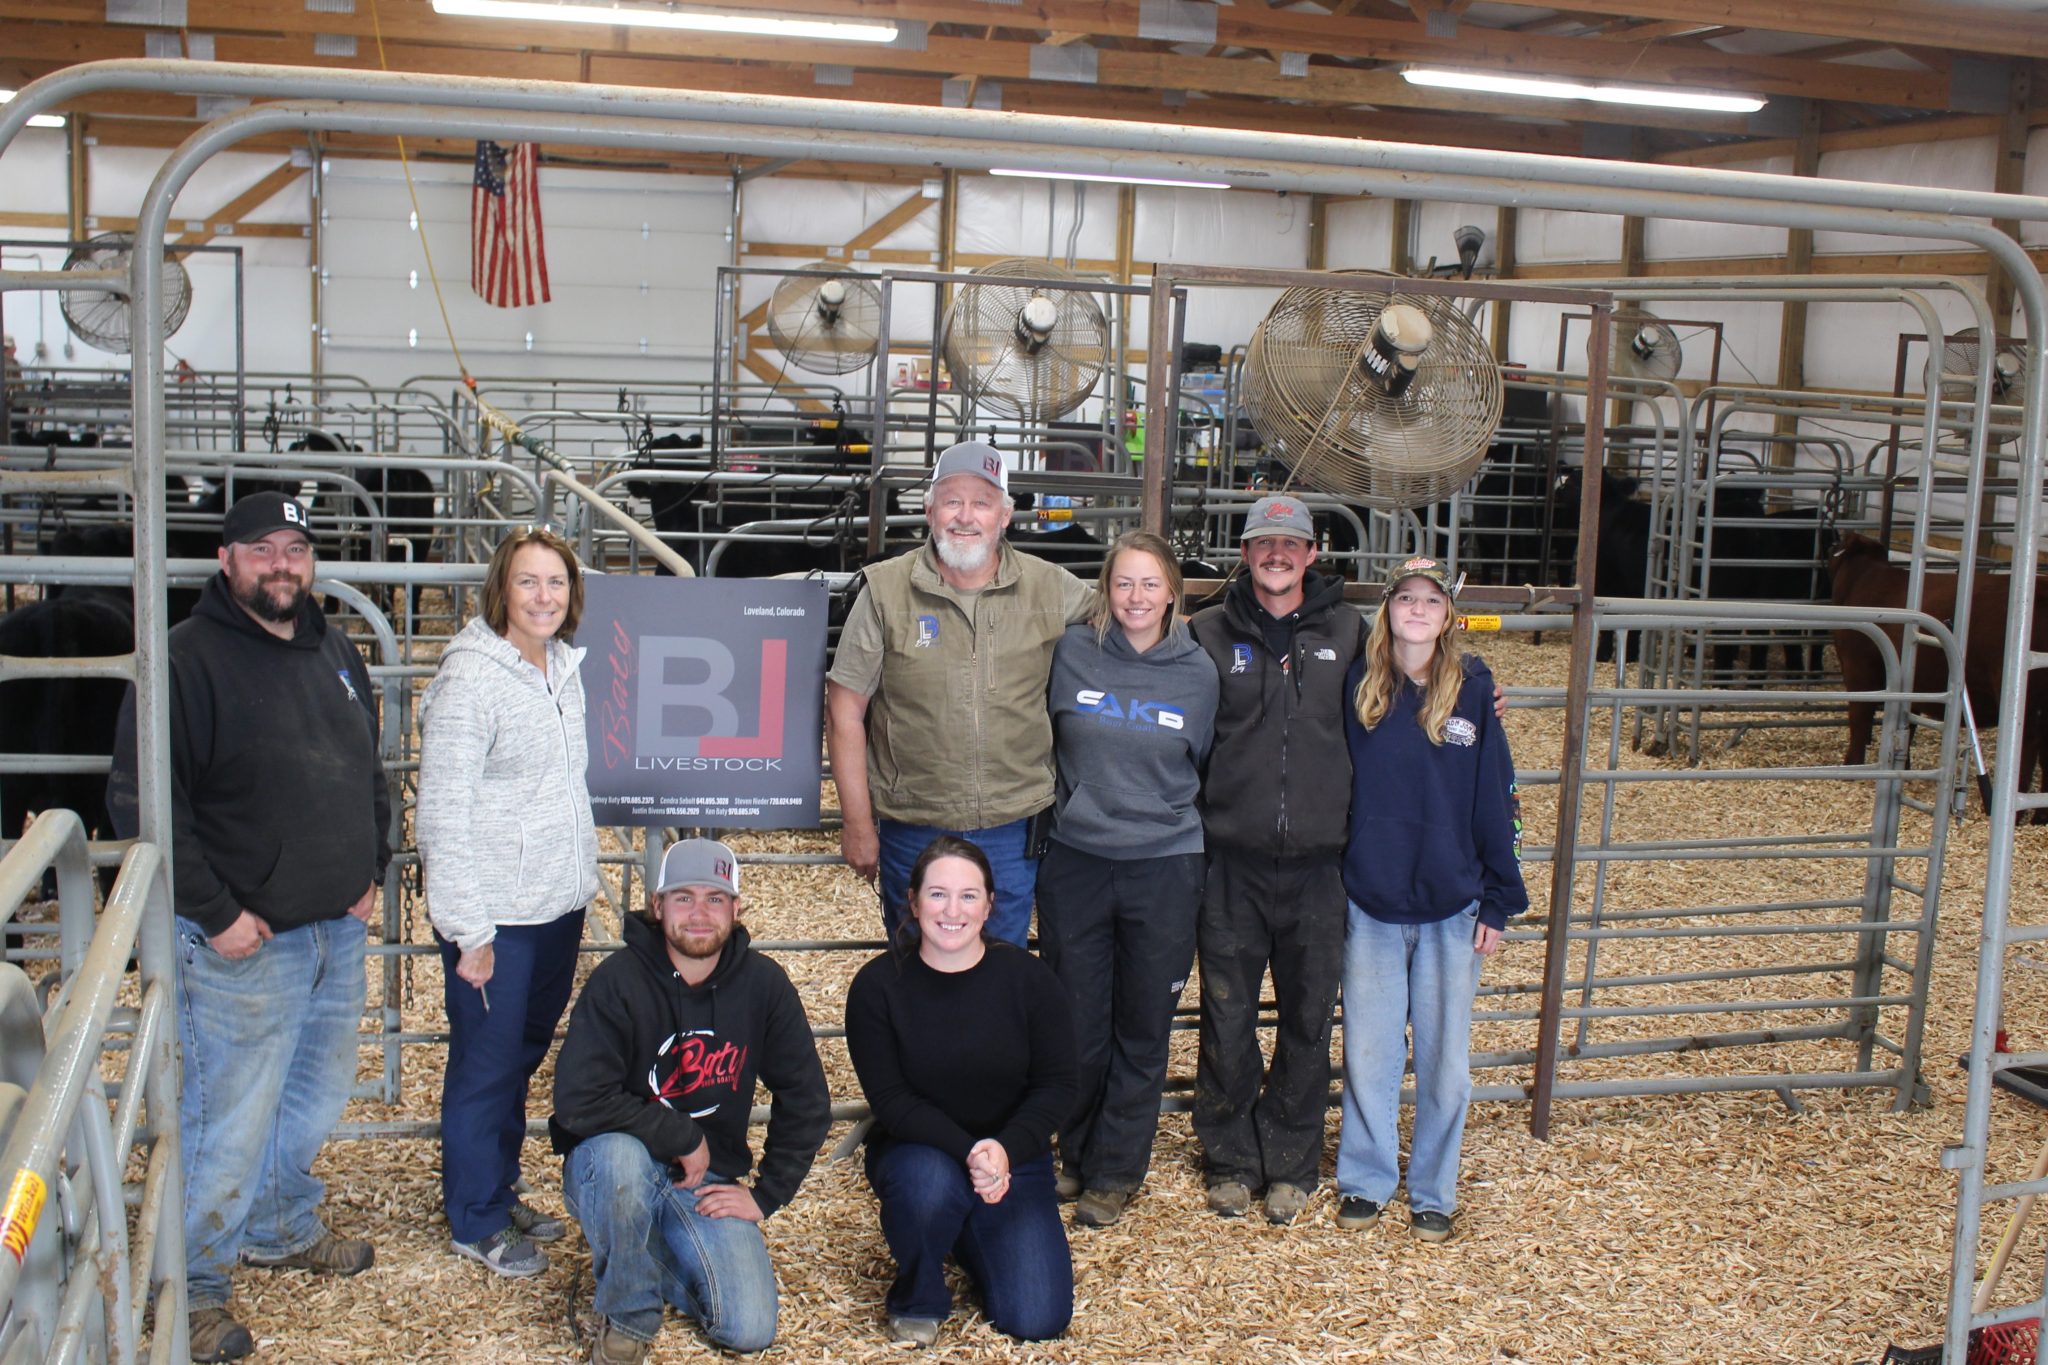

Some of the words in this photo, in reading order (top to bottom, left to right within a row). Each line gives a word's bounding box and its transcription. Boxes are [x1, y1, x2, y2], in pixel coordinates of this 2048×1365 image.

[743, 605, 776, 617] Loveland,
[776, 606, 805, 617] Colorado
[635, 757, 782, 771] LIVESTOCK
